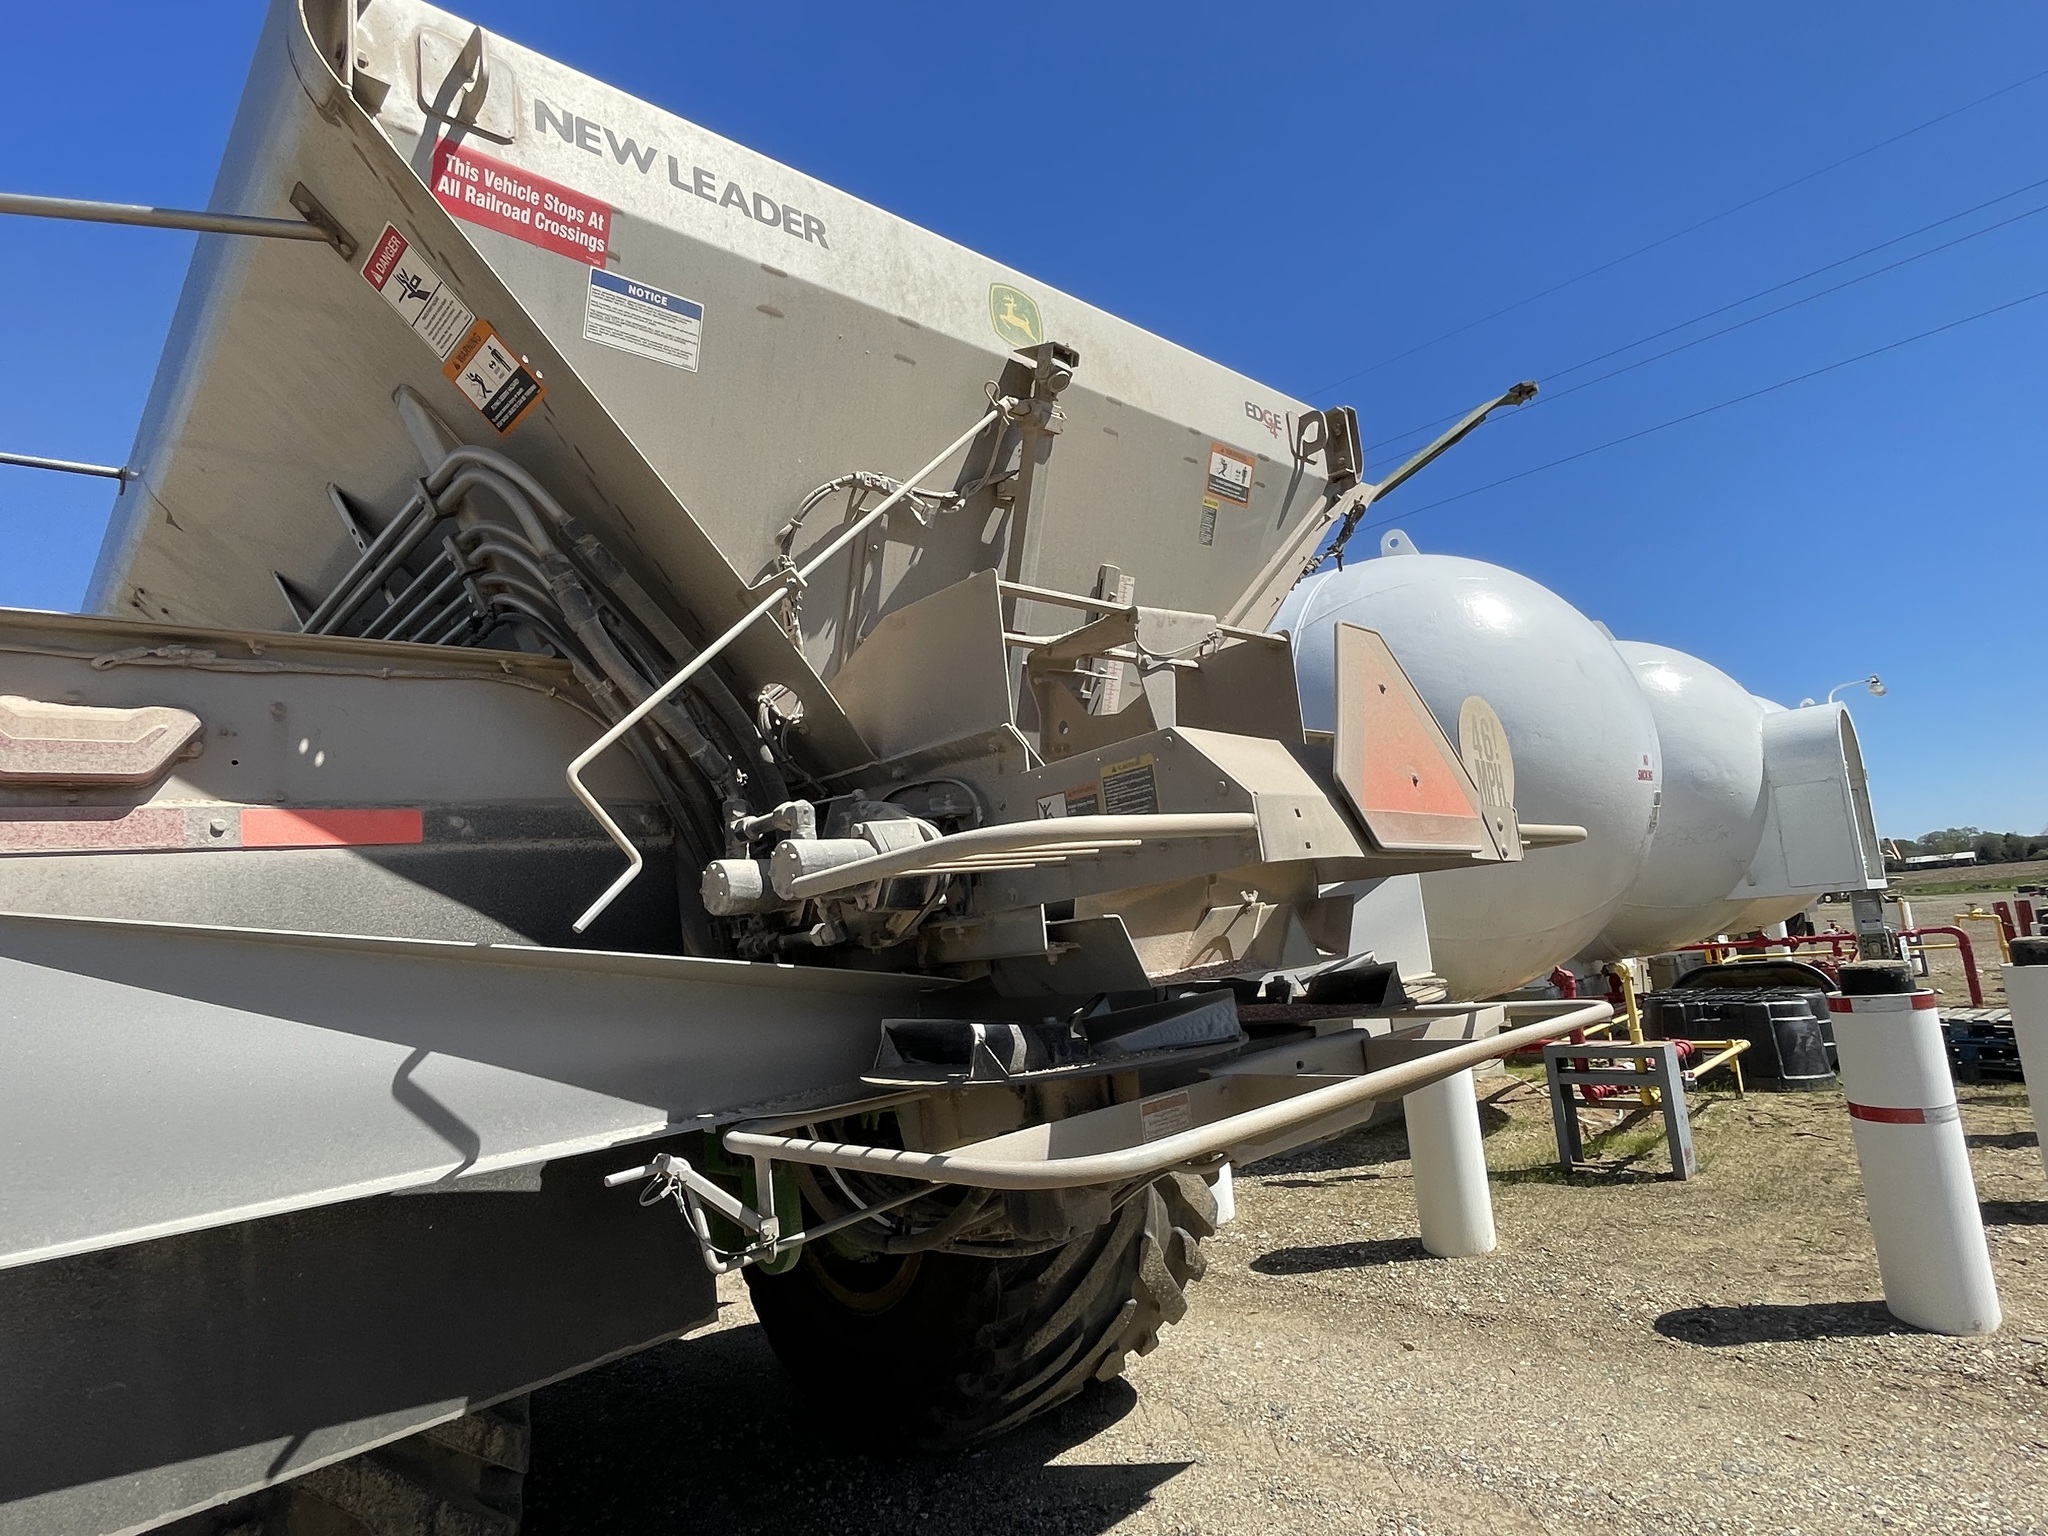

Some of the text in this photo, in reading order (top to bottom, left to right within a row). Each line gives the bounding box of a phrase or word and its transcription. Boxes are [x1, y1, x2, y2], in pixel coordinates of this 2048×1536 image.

[445, 153, 604, 231] This Vehicle Stops At
[534, 98, 829, 250] NEW LEADER
[437, 175, 605, 253] All Railroad Crossings
[375, 235, 402, 275] DANGER
[628, 284, 668, 306] NOTICE
[456, 332, 482, 362] WARNING
[1244, 401, 1282, 431] EDGE
